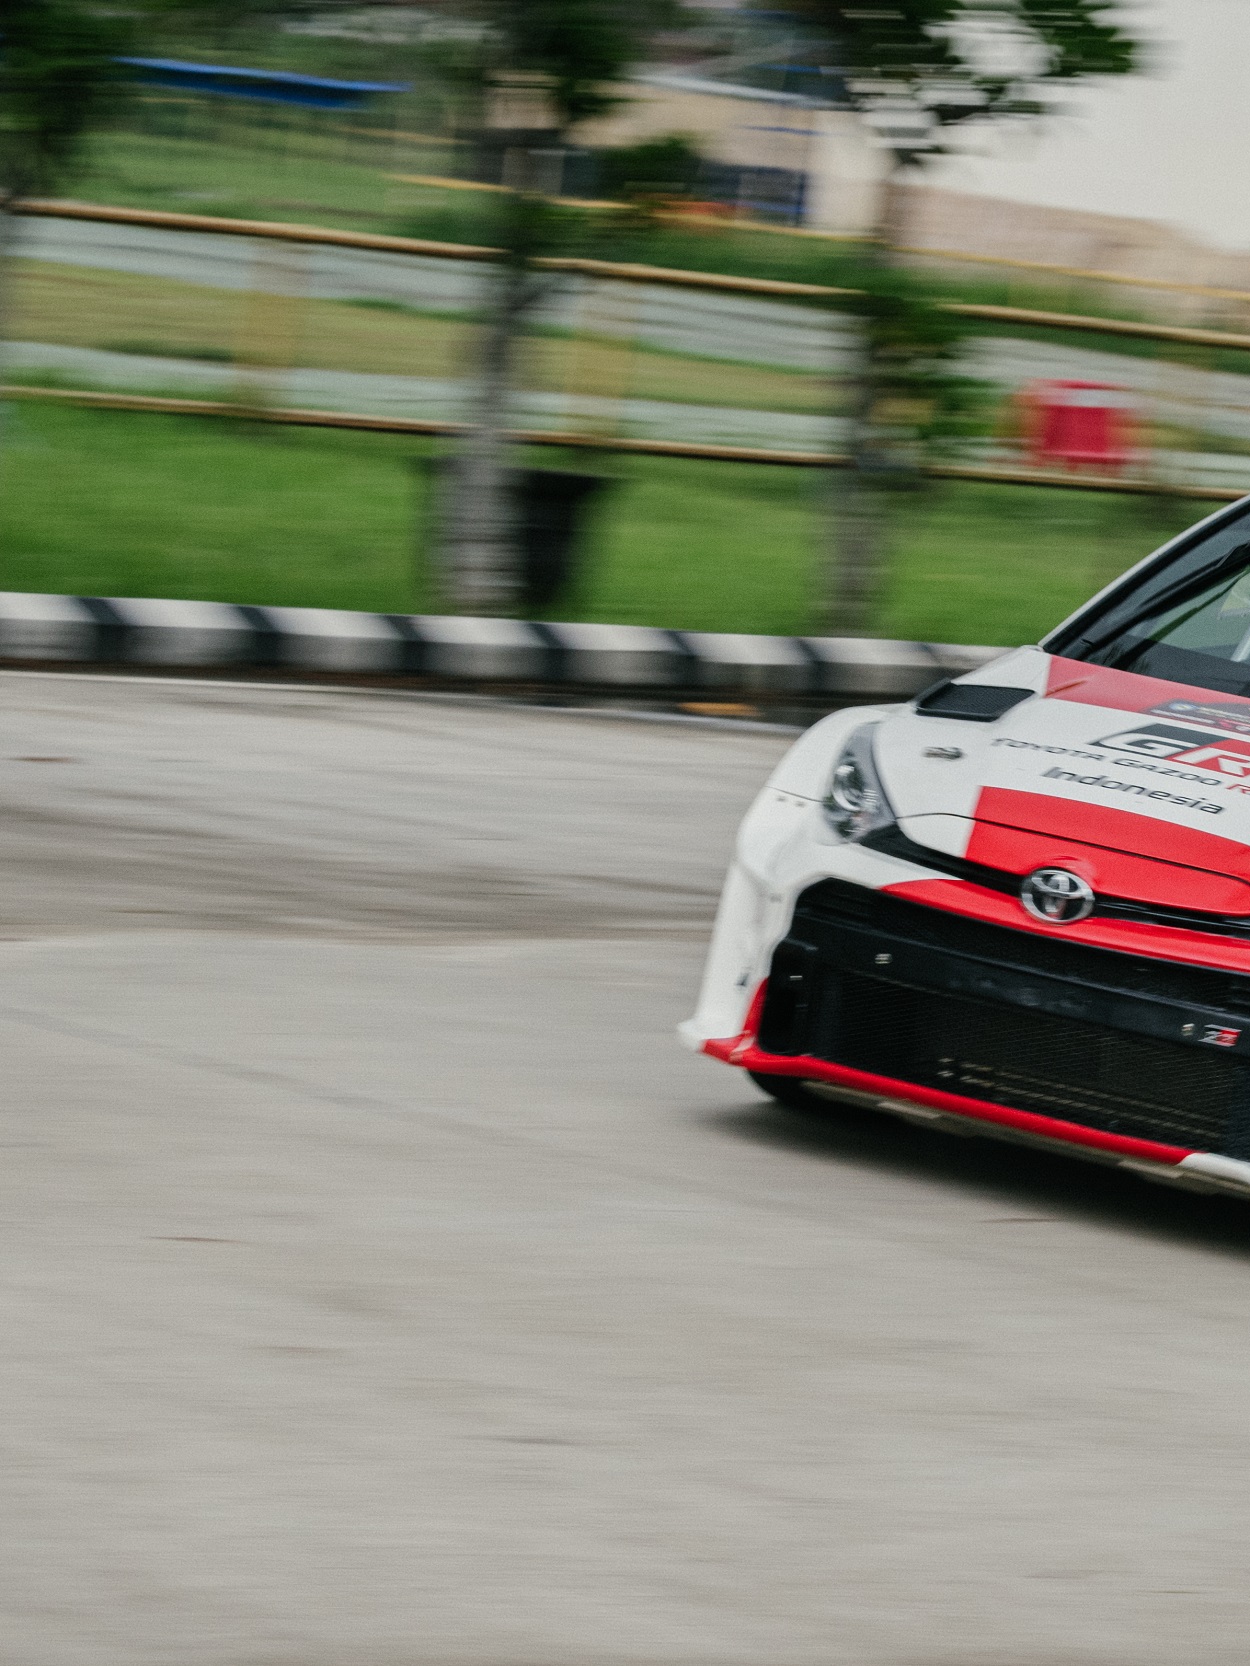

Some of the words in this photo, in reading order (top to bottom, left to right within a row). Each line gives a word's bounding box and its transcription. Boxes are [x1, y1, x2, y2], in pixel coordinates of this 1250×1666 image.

[990, 737, 1106, 763] TOYOTA
[1111, 757, 1222, 786] GAZOO
[1040, 766, 1225, 815] Indonesia
